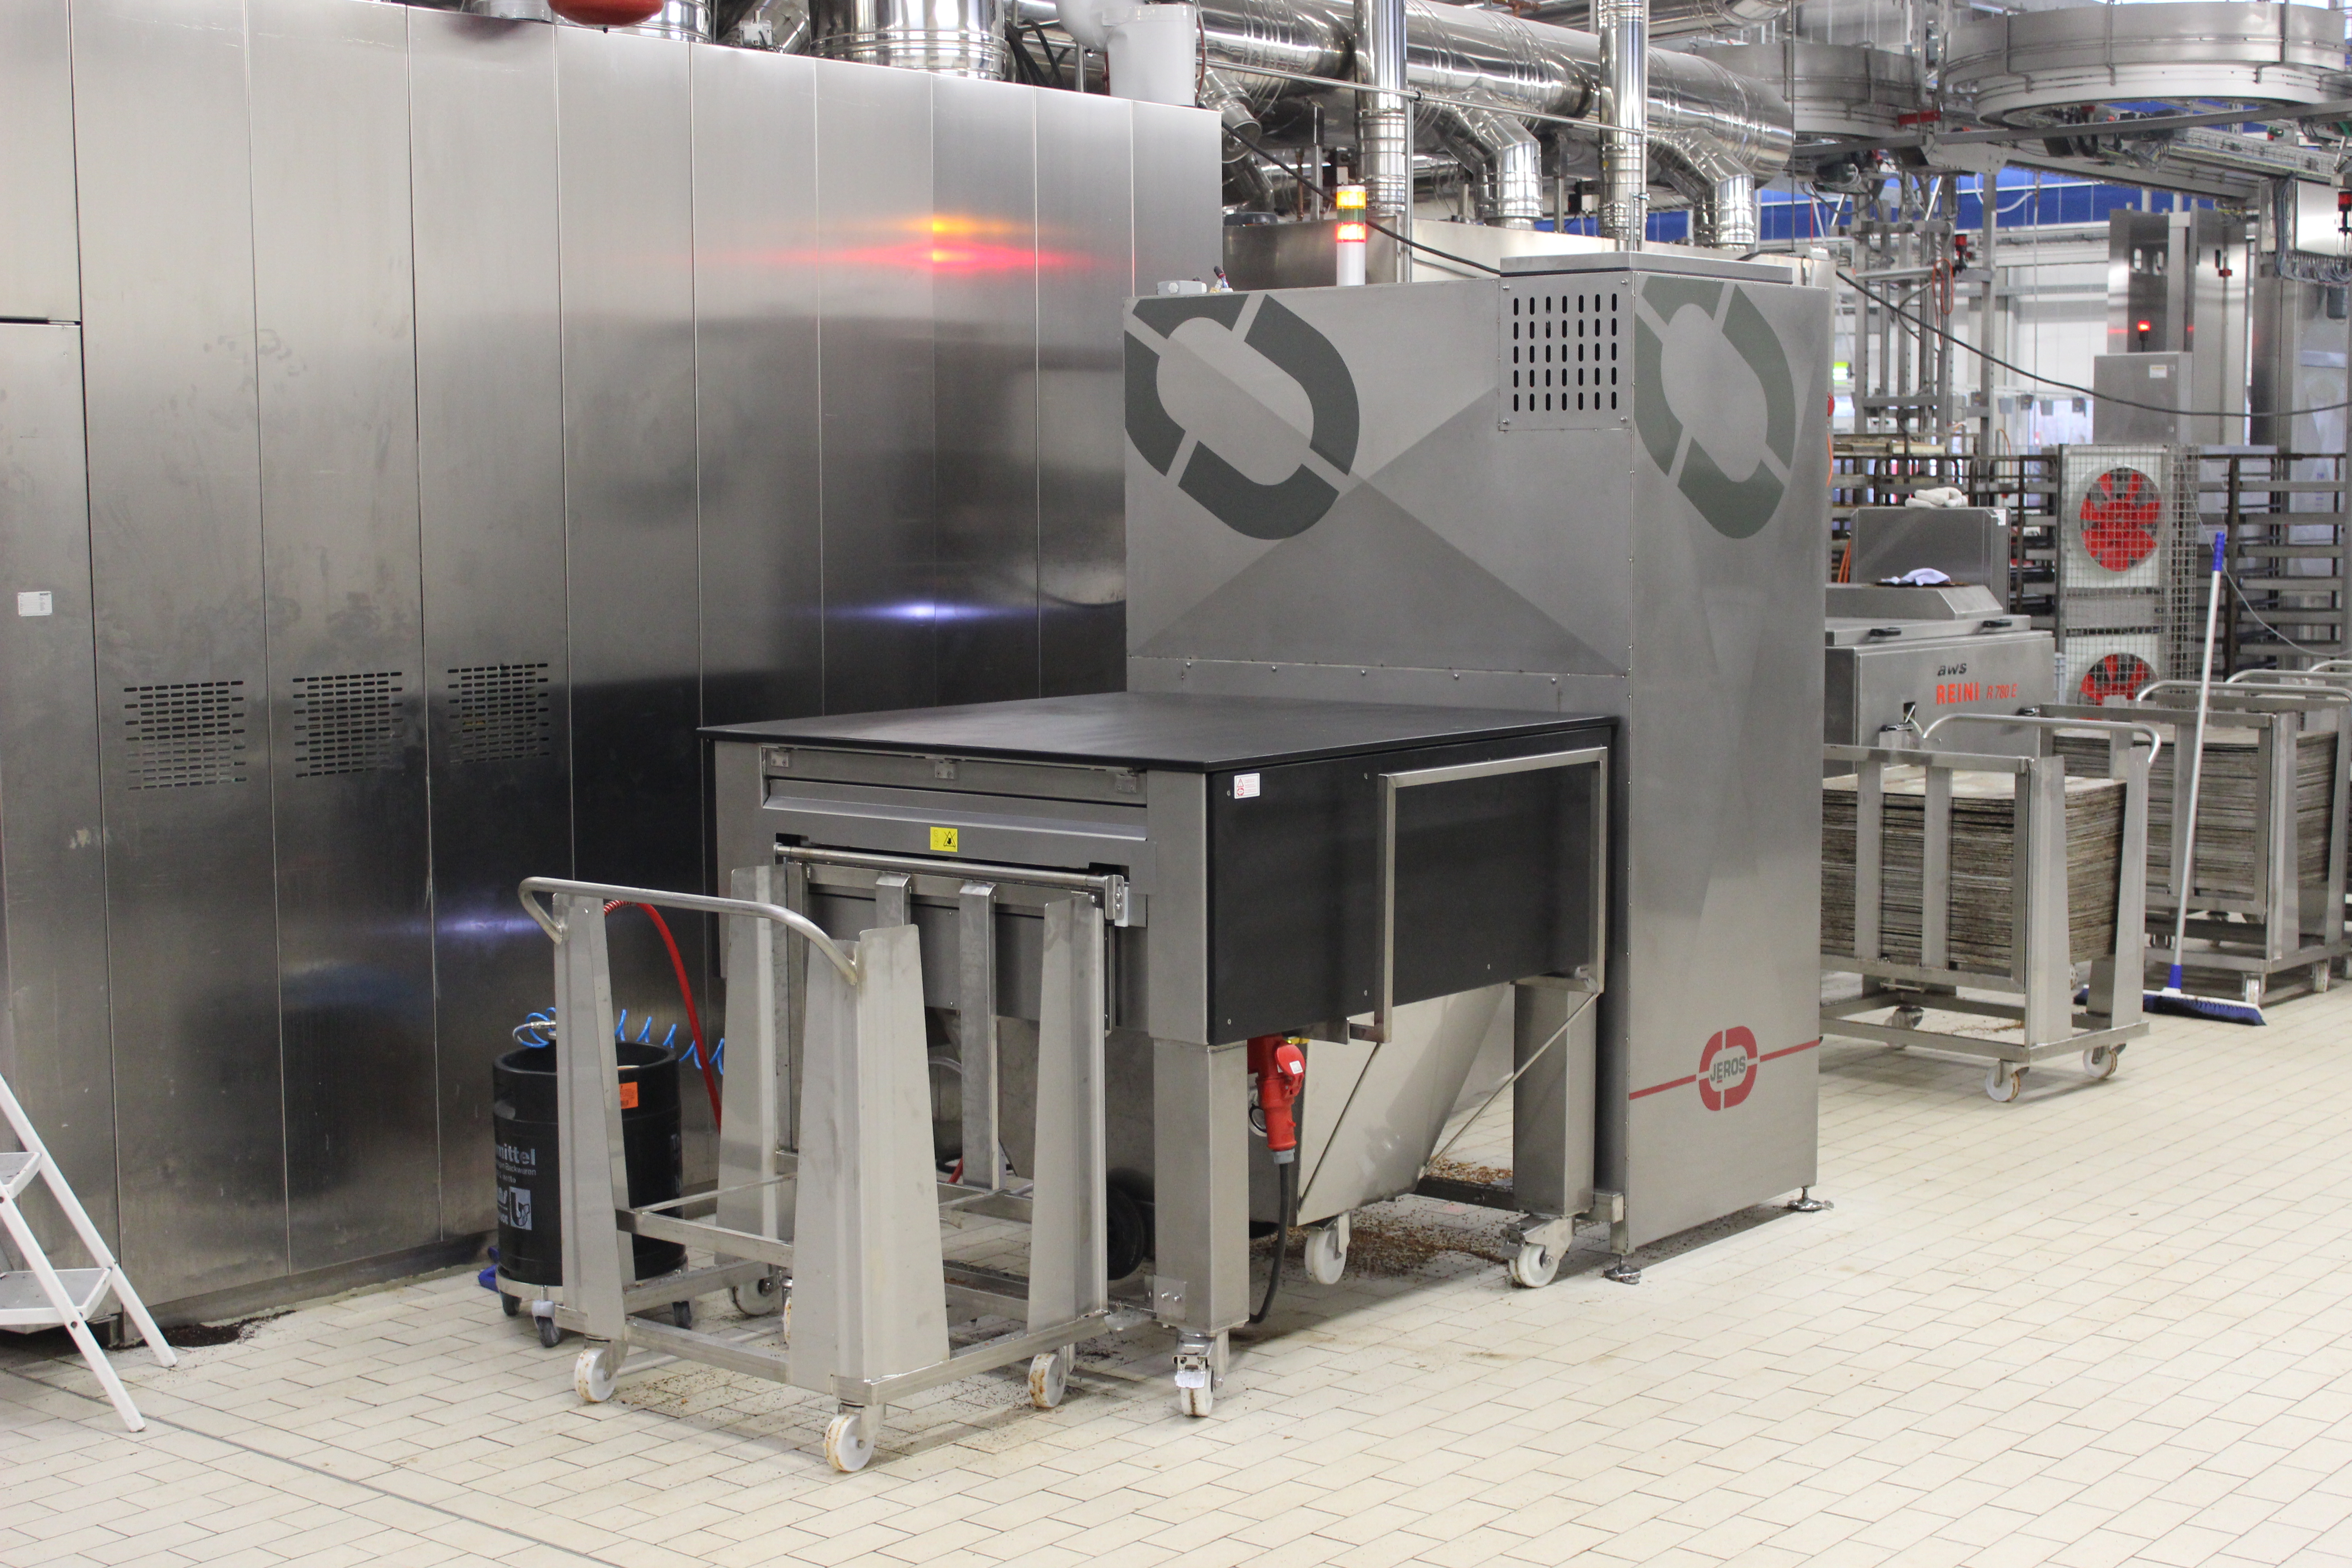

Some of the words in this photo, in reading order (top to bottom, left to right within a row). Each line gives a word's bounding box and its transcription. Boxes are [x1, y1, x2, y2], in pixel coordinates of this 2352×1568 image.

[1937, 663, 1967, 676] aws
[1936, 682, 1980, 705] REINI
[1987, 685, 1994, 699] R
[1996, 685, 2010, 699] 780
[2011, 683, 2019, 698] E
[1710, 1056, 1746, 1082] JEROS
